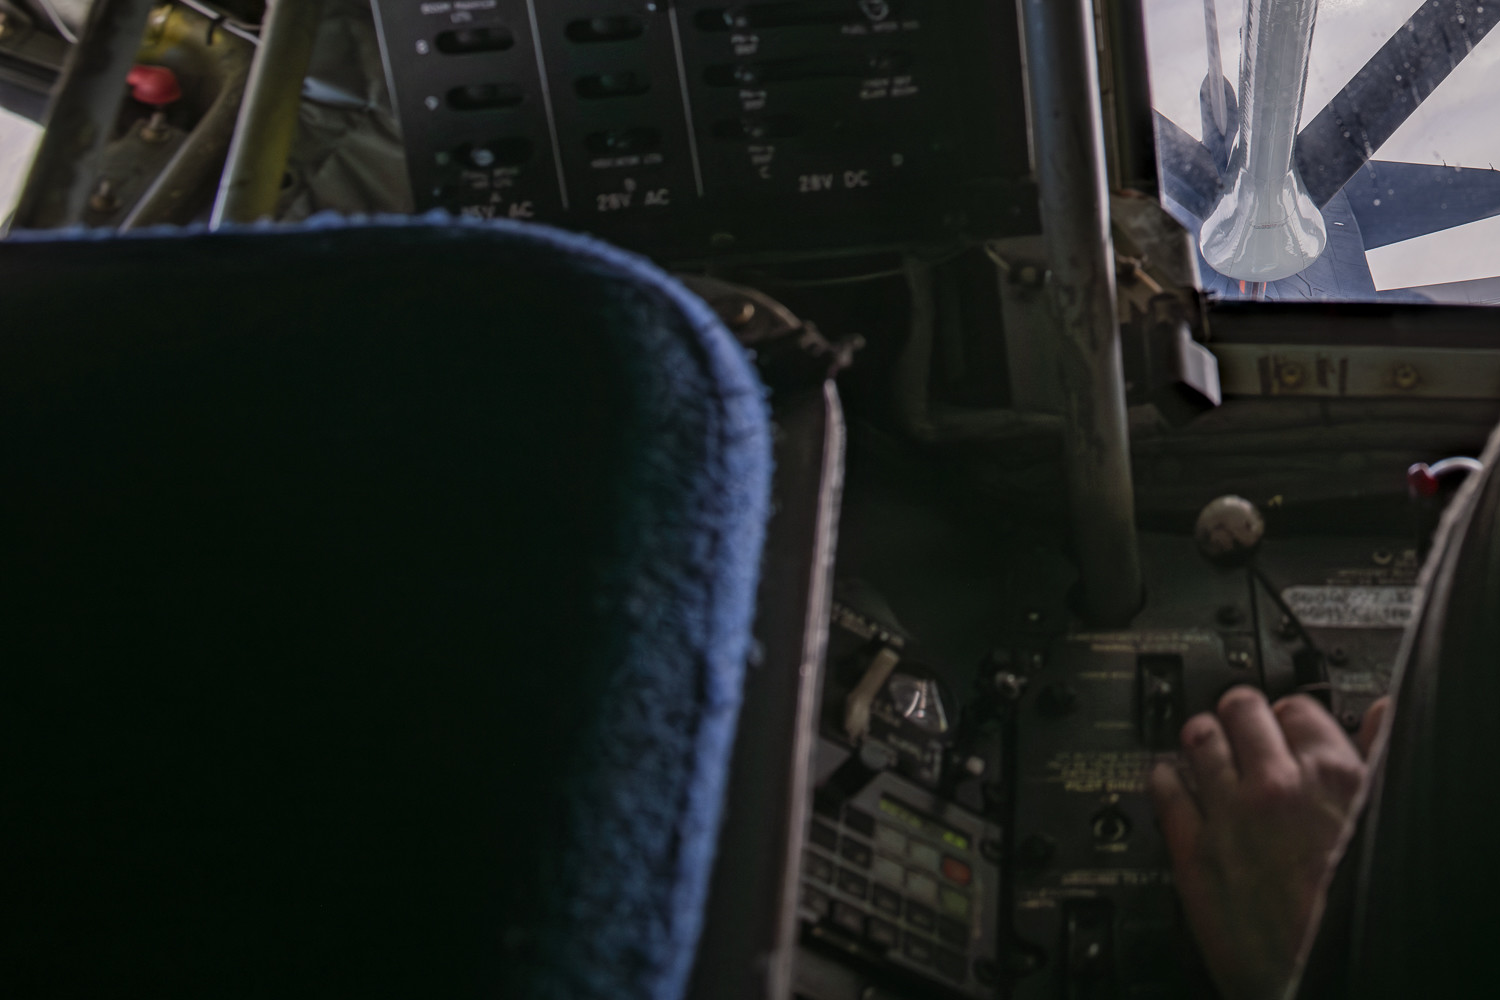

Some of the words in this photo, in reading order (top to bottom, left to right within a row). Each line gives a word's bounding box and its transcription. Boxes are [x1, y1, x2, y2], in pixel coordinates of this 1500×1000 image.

[798, 173, 834, 193] 28V
[843, 169, 871, 189] DC
[643, 187, 671, 207] AC
[507, 200, 536, 219] AC
